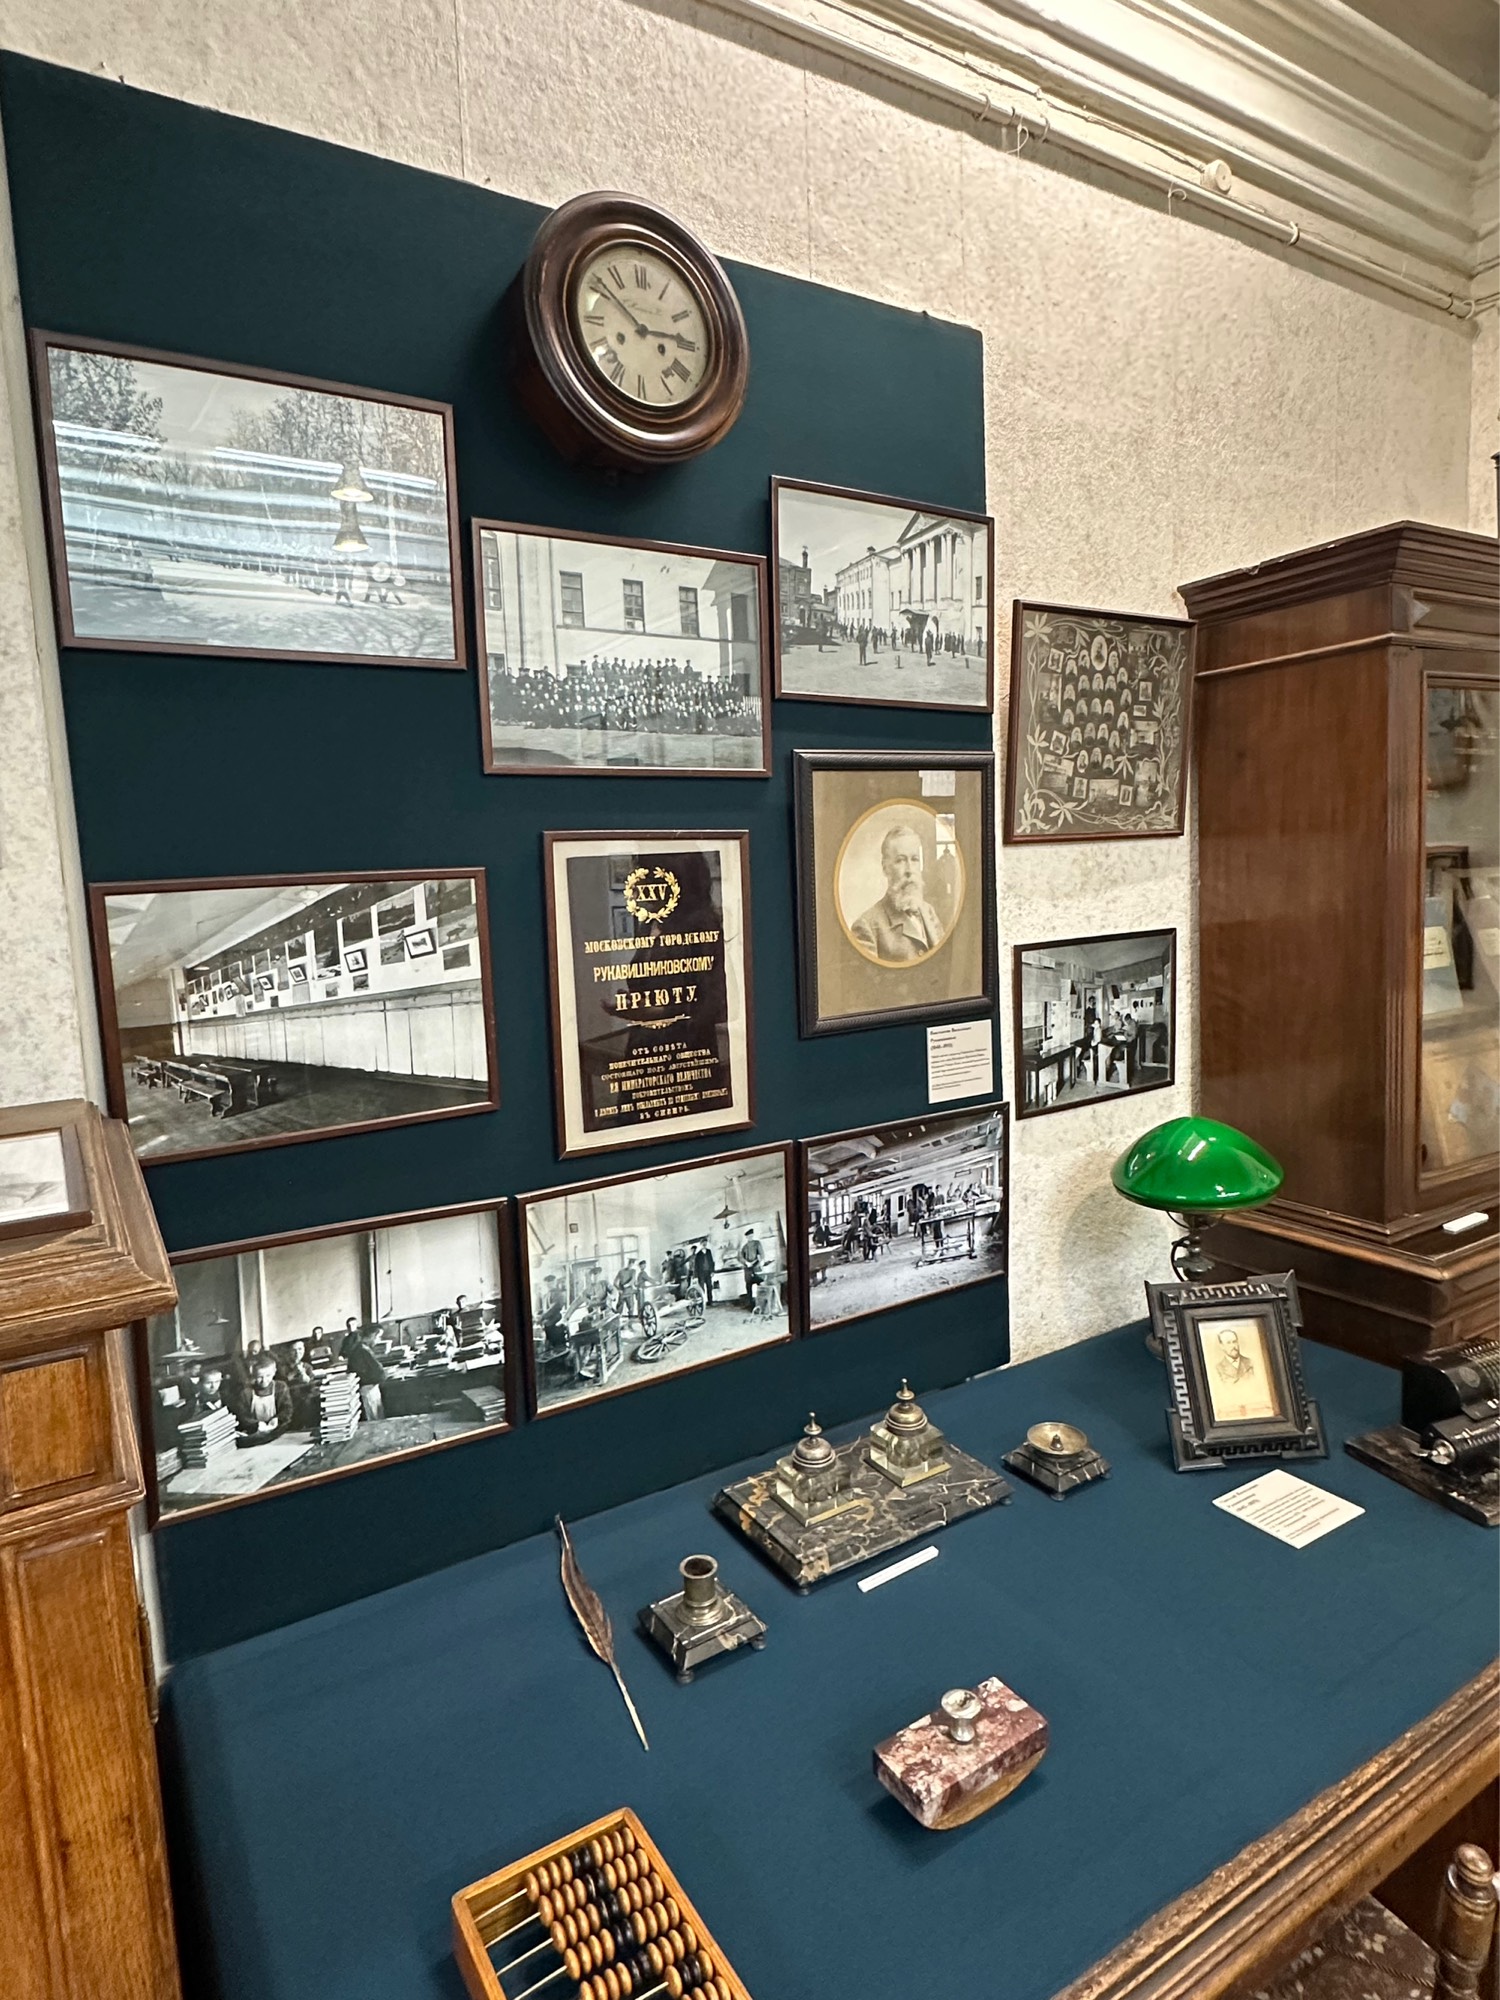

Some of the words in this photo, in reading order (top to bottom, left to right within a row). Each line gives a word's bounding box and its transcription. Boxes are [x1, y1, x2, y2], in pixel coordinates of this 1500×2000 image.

[636, 883, 668, 902] XXV
[583, 935, 656, 954] МОСКОВСКОМУ
[659, 930, 720, 947] ГОРОДСКОМУ
